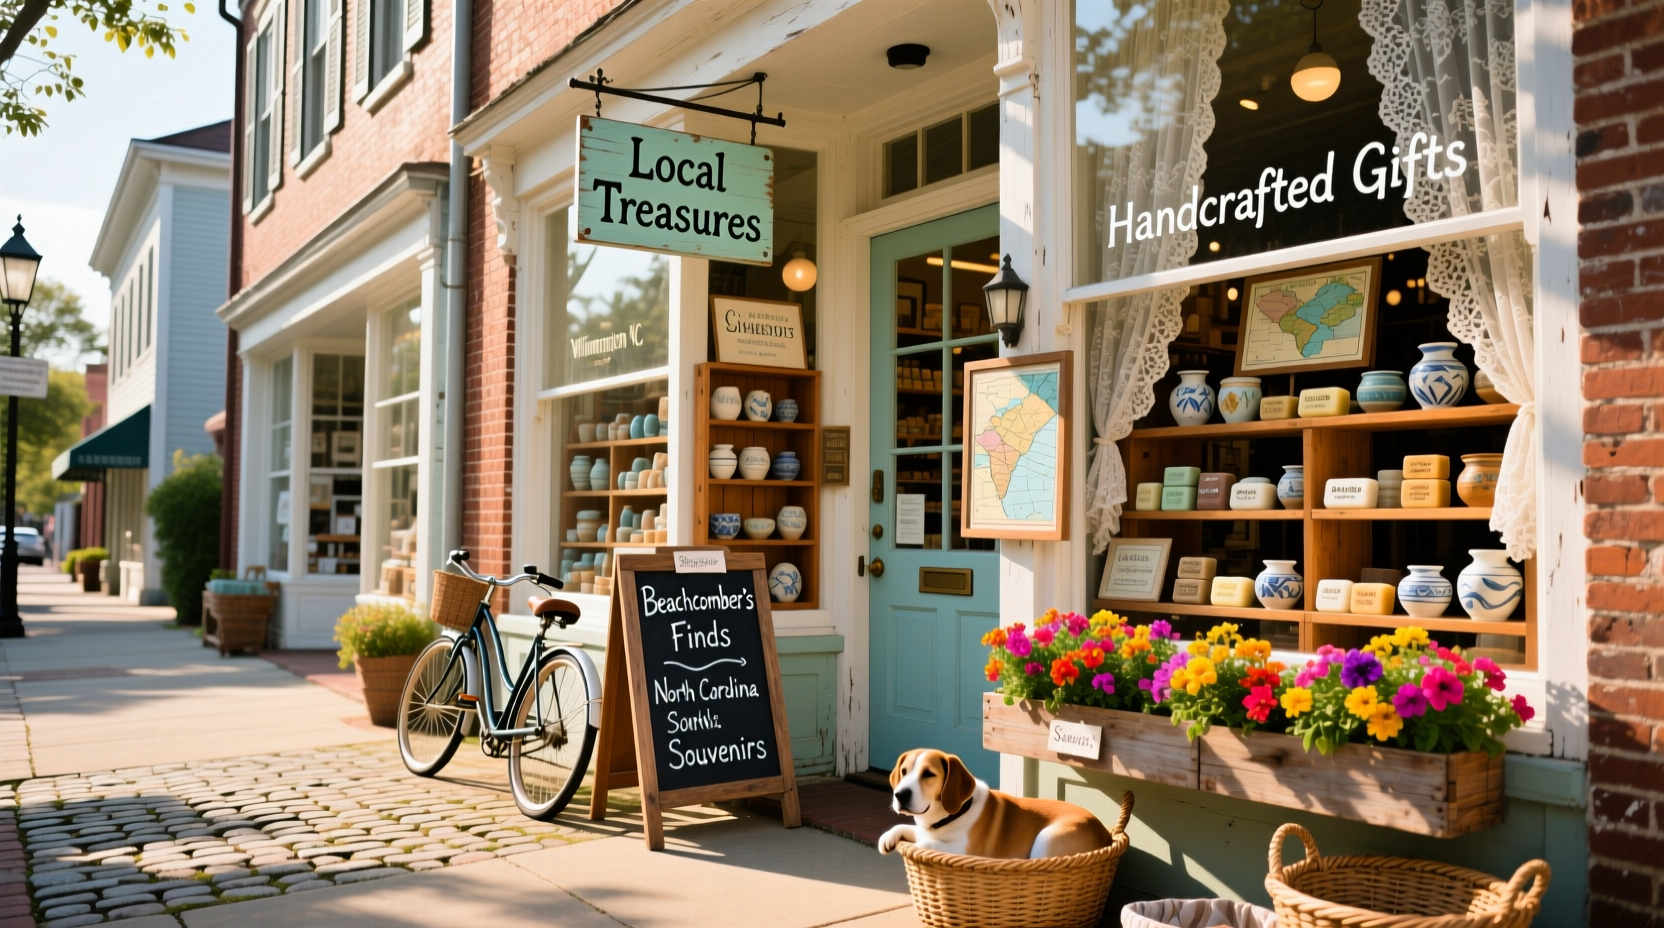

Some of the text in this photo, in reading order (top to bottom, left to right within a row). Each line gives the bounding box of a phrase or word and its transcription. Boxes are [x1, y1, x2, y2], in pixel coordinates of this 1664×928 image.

[629, 136, 727, 192] Local
[1107, 131, 1468, 249] Handcrafted Gifts
[593, 178, 761, 242] Treasures
[640, 584, 755, 617] Beachcomber's
[670, 619, 732, 652] Finds
[654, 676, 696, 705] North
[668, 736, 767, 770] Souvenirs
